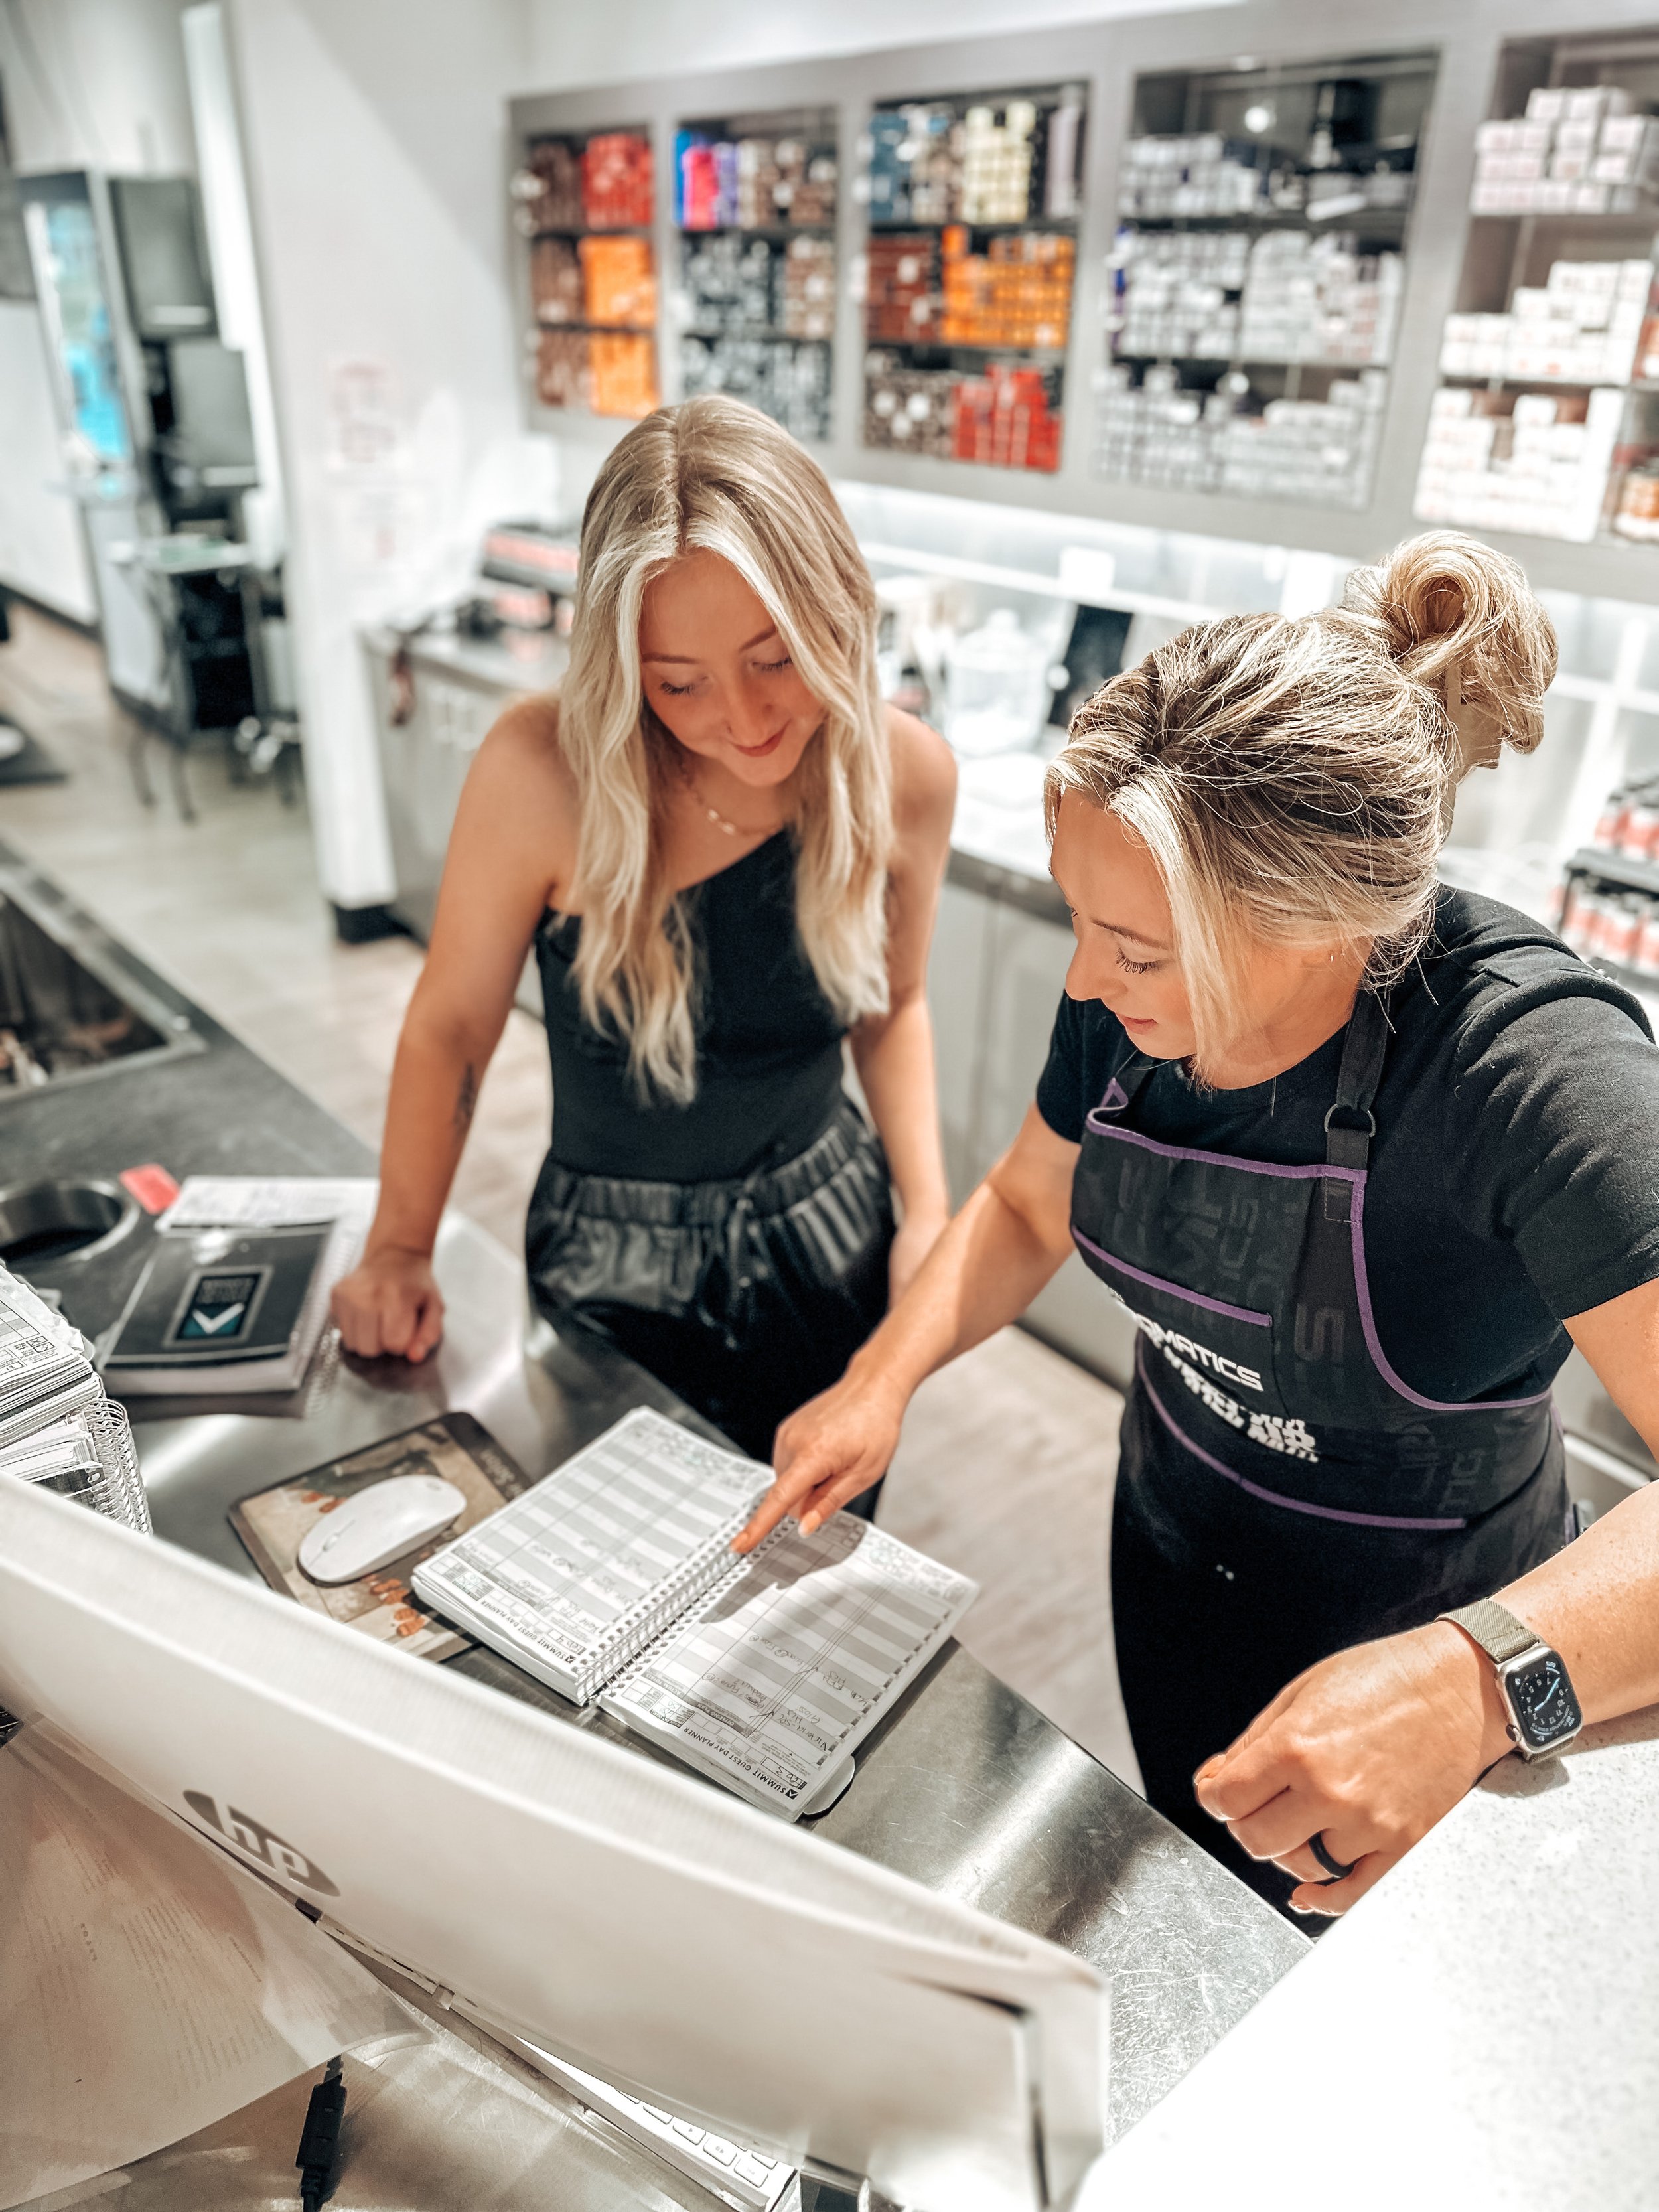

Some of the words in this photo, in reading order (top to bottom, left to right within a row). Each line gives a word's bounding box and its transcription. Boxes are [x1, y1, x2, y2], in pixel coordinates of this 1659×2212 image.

[479, 1599, 507, 1618] PLANNER
[504, 1615, 519, 1627] DAY
[517, 1624, 538, 1641] GUEST
[555, 1634, 565, 1644] 4
[536, 1637, 567, 1660] SUMMIT
[662, 1682, 681, 1694] ACTUAL
[696, 1702, 711, 1712] PLAN
[710, 1710, 735, 1726] OFFERING
[682, 1726, 715, 1747] PLANNER
[795, 1725, 827, 1751] Victoria
[713, 1743, 729, 1756] DAY
[727, 1752, 752, 1771] GUEST
[774, 1765, 784, 1776] 3
[751, 1768, 786, 1794] SUMMIT
[212, 1793, 311, 1882] hp
